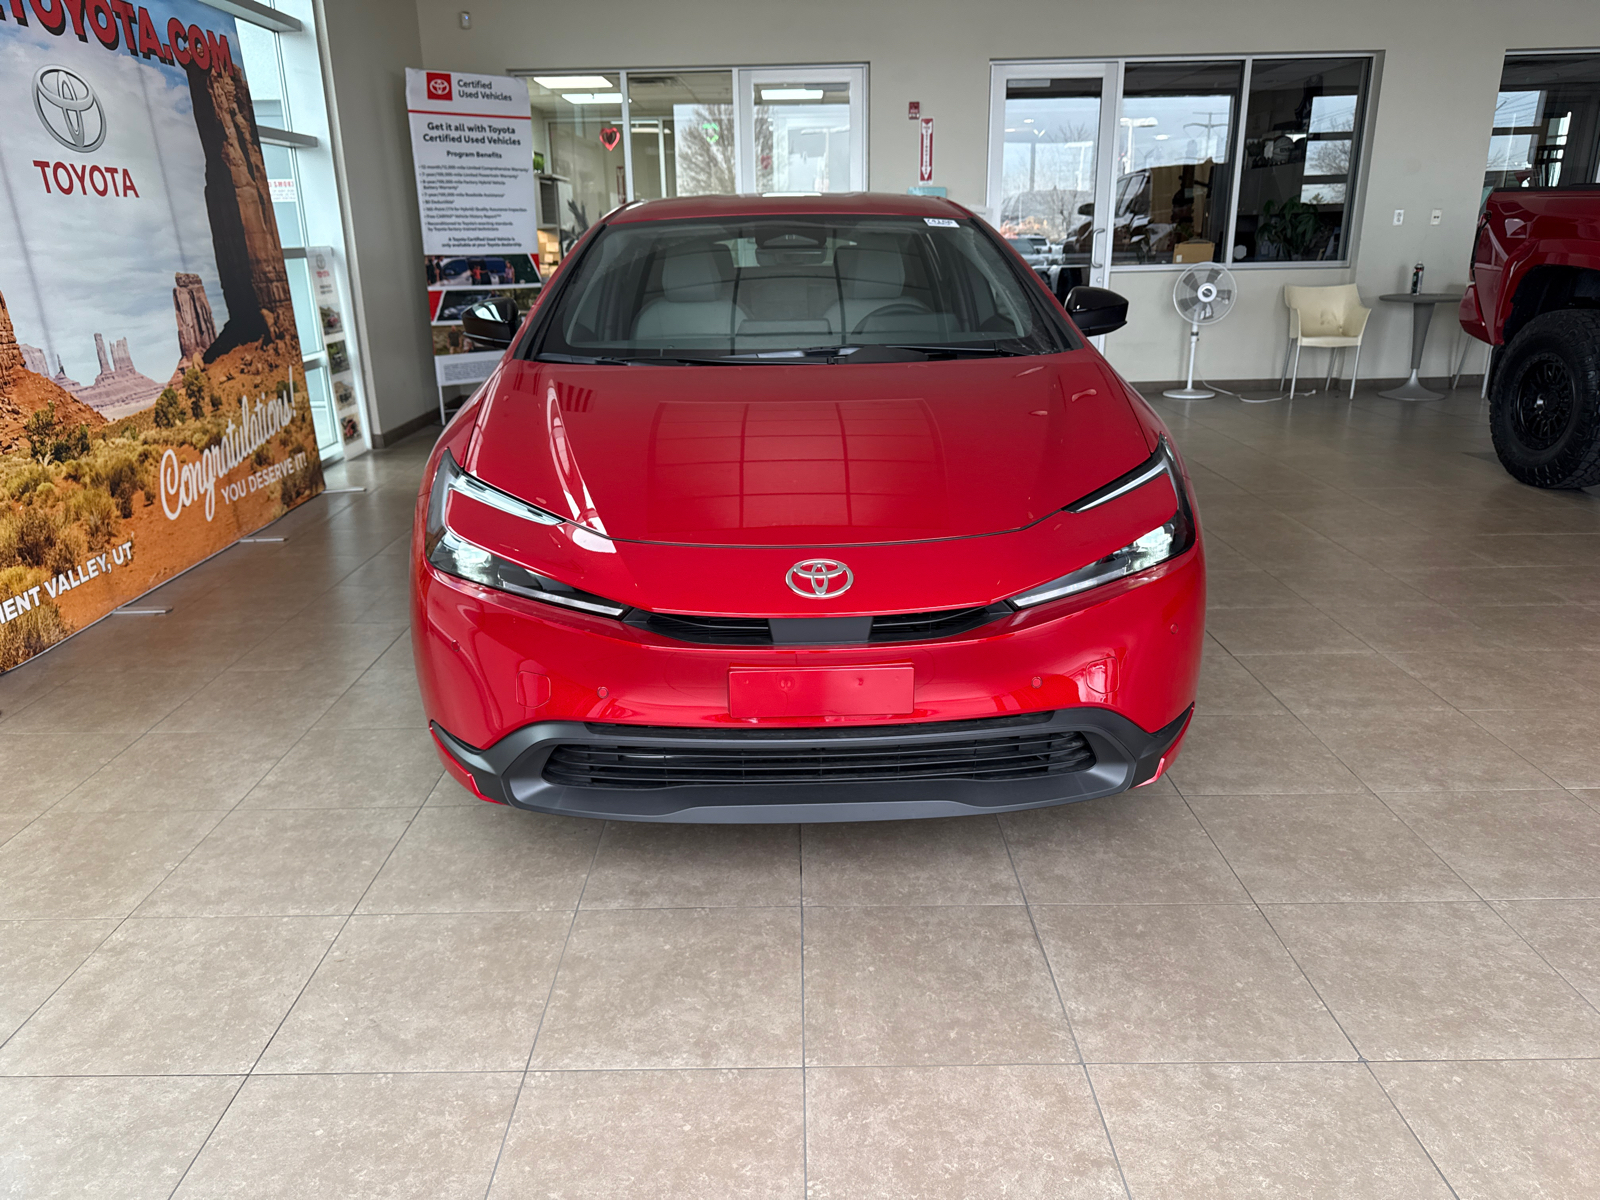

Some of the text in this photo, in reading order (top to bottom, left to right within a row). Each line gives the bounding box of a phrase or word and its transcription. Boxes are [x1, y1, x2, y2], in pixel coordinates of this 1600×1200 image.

[457, 79, 492, 90] Certified
[458, 90, 512, 101] Used Vehicles
[427, 122, 516, 135] Get it all with Toyota
[423, 133, 521, 146] Certified Used Vehicles
[446, 150, 502, 159] Program Benefits
[32, 160, 140, 198] TOYOTA
[160, 366, 296, 522] Congratulations!
[221, 452, 308, 505] YOU DESERVE IT!
[44, 553, 112, 599] VALLEY,
[112, 541, 132, 566] UT
